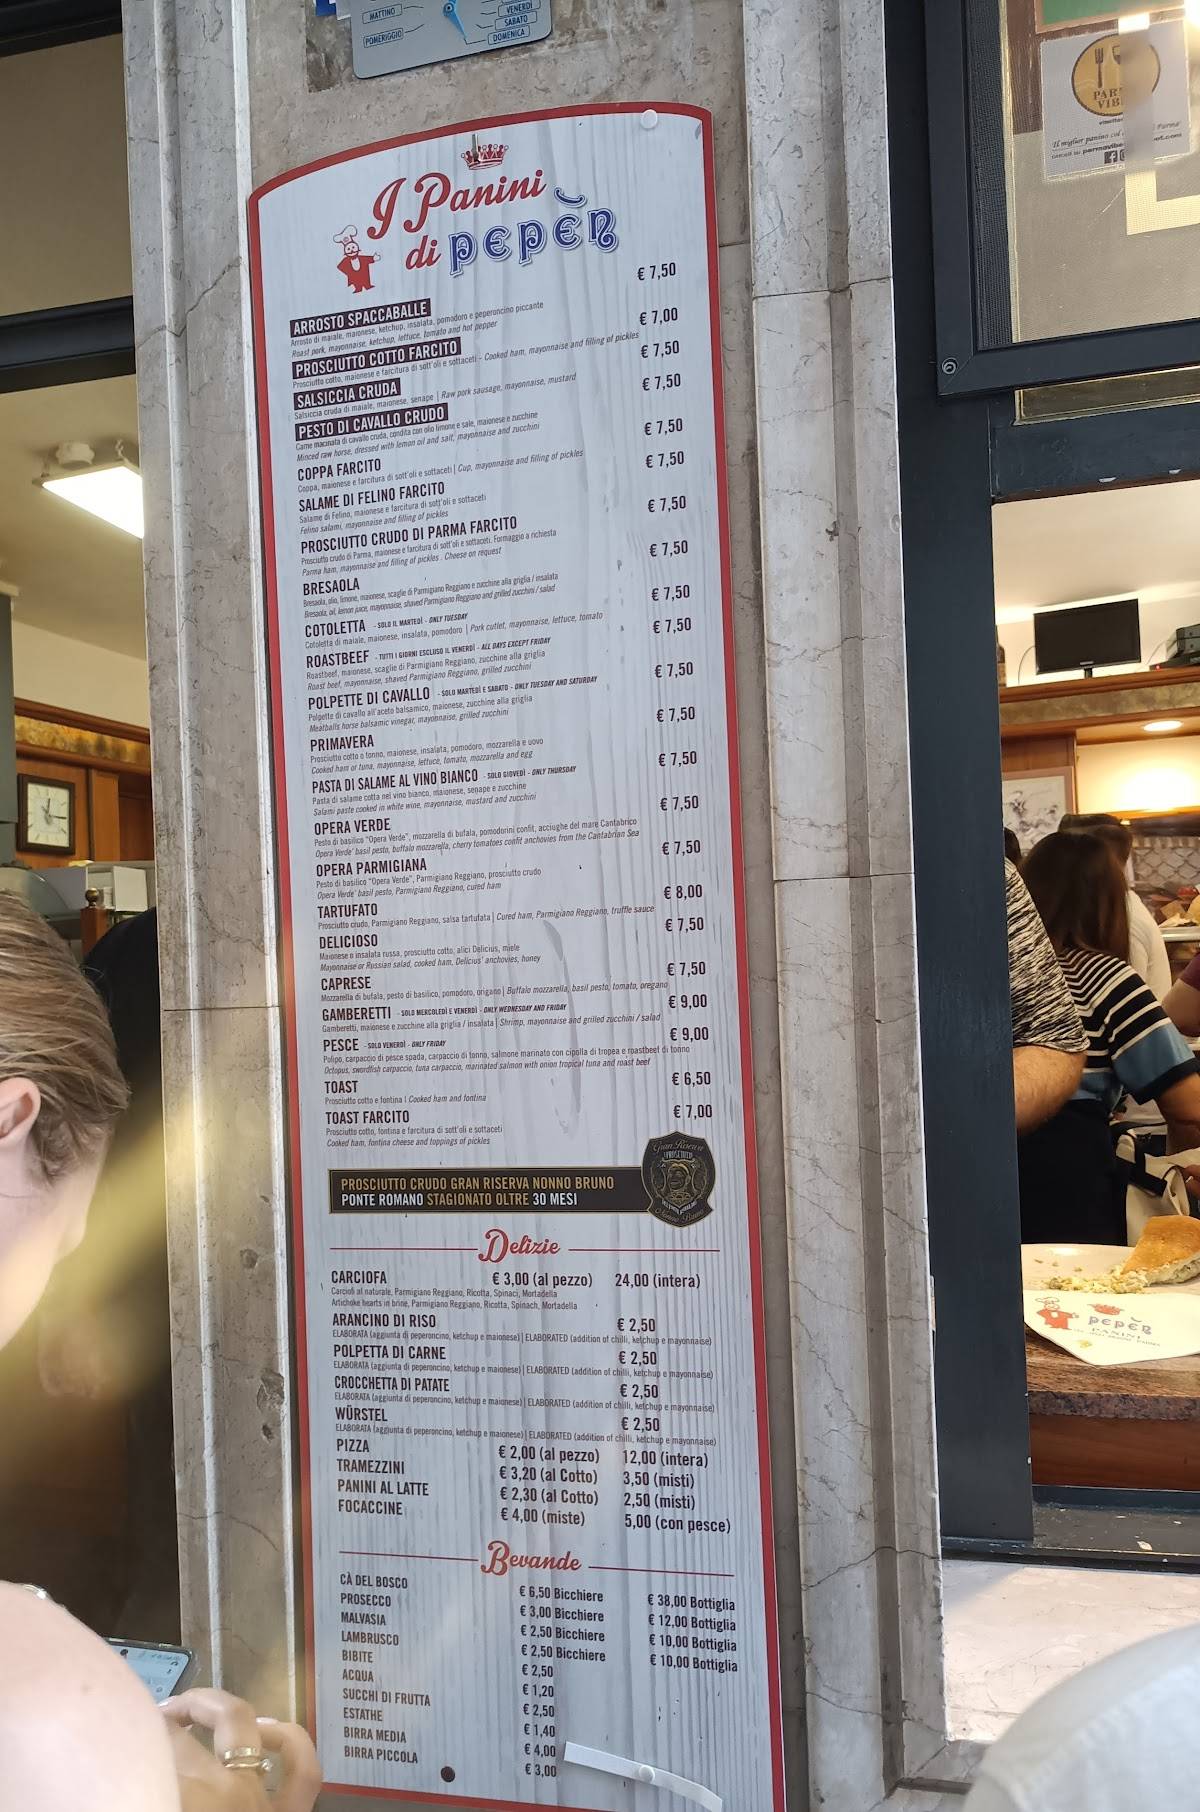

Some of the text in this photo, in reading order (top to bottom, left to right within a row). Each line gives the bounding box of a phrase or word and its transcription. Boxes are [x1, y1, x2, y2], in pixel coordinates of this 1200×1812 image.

[369, 8, 395, 20] MATTINO
[505, 15, 528, 26] SABATO
[365, 30, 402, 46] POMERIGGIO
[493, 28, 525, 41] DOMENICA
[403, 169, 547, 232] Panini
[405, 235, 442, 270] di
[649, 261, 676, 280] 7,50
[293, 300, 427, 335] ARROSTO SPACCABALLE
[652, 307, 678, 325] 7,00
[295, 340, 458, 377] PROSCIUTTO COTTO FARCITO
[296, 380, 398, 408] SALSICCIA CRUDA
[293, 408, 322, 421] Salsiccia
[323, 405, 341, 416] cruda
[343, 404, 349, 413] di
[351, 400, 374, 412] maiale,
[441, 389, 455, 400] Raw
[456, 387, 470, 398] pork
[298, 405, 445, 439] PESTO DI CAVALLO CRUDO
[297, 457, 382, 482] COPPA FARCITO
[298, 481, 445, 512] SALAME DI FELINO FARCITO
[300, 515, 518, 554] PROSCIUTTO CRUDO DI PARMA FARCITO
[302, 576, 360, 596] BRESAOLA
[304, 619, 366, 638] COTOLETTA
[305, 649, 370, 668] ROASTBEEF
[307, 686, 431, 710] POLPETTE DI CAVALLO
[309, 734, 374, 752] PRIMAVERA
[311, 768, 478, 794] PASTA DI SALAME AL VINO BIANCO
[313, 817, 391, 835] OPERA VERDE
[315, 857, 427, 877] OPERA PARMIGIANA
[676, 883, 703, 900] 8,00
[317, 902, 378, 918] TARTUFATO
[318, 933, 378, 949] DELICIOSO
[320, 976, 371, 991] CAPRESE
[321, 1006, 391, 1021] GAMBERETTI
[322, 1038, 359, 1052] PESCE
[324, 1080, 359, 1094] TOAST
[325, 1110, 410, 1124] TOAST FARCITO
[340, 1176, 615, 1191] PROSCIUTTO CRUDO GRAN RISERVA NONNO BRUNO
[340, 1192, 578, 1206] PONTE ROMANO STAGIONATO OLTRE 30 MESI
[476, 1227, 562, 1263] Delizie
[330, 1270, 387, 1284] CARCIOFA
[504, 1271, 528, 1288] 3,00
[533, 1271, 548, 1288] (al
[552, 1271, 593, 1289] pezzo)
[614, 1272, 700, 1289] 24,00 (intera)
[332, 1312, 436, 1328] ARANCINO DI RISO
[332, 1344, 446, 1360] POLPETTA DI CARNE
[334, 1375, 449, 1392] CROCCHETTA DI PATATE
[334, 1404, 388, 1421] WÜRSTEL
[336, 1438, 369, 1452] PIZZA
[336, 1458, 405, 1474] TRAMEZZINI
[337, 1478, 429, 1496] PANINI AL LATTE
[338, 1498, 403, 1515] FOCACCINE
[624, 1513, 731, 1535] 5,00 (con pesce)
[478, 1538, 582, 1580] Bevande
[339, 1571, 408, 1589] CÀ DEL BOSCO
[340, 1592, 391, 1607] PROSECCO
[529, 1585, 550, 1599] 6,50
[554, 1587, 604, 1602] Bicchiere
[657, 1594, 686, 1608] 38,00
[690, 1596, 735, 1611] Bottiglia
[340, 1611, 386, 1626] MALVASIA
[341, 1630, 399, 1646] LAMBRUSCO
[341, 1649, 373, 1663] BIBITE
[342, 1668, 374, 1683] ACQUA
[342, 1687, 431, 1707] SUCCHI DI FRUTTA
[343, 1707, 383, 1722] ESTATHE
[343, 1725, 406, 1743] BIRRA MEDIA
[343, 1745, 418, 1764] BIRRA PICCOLA
